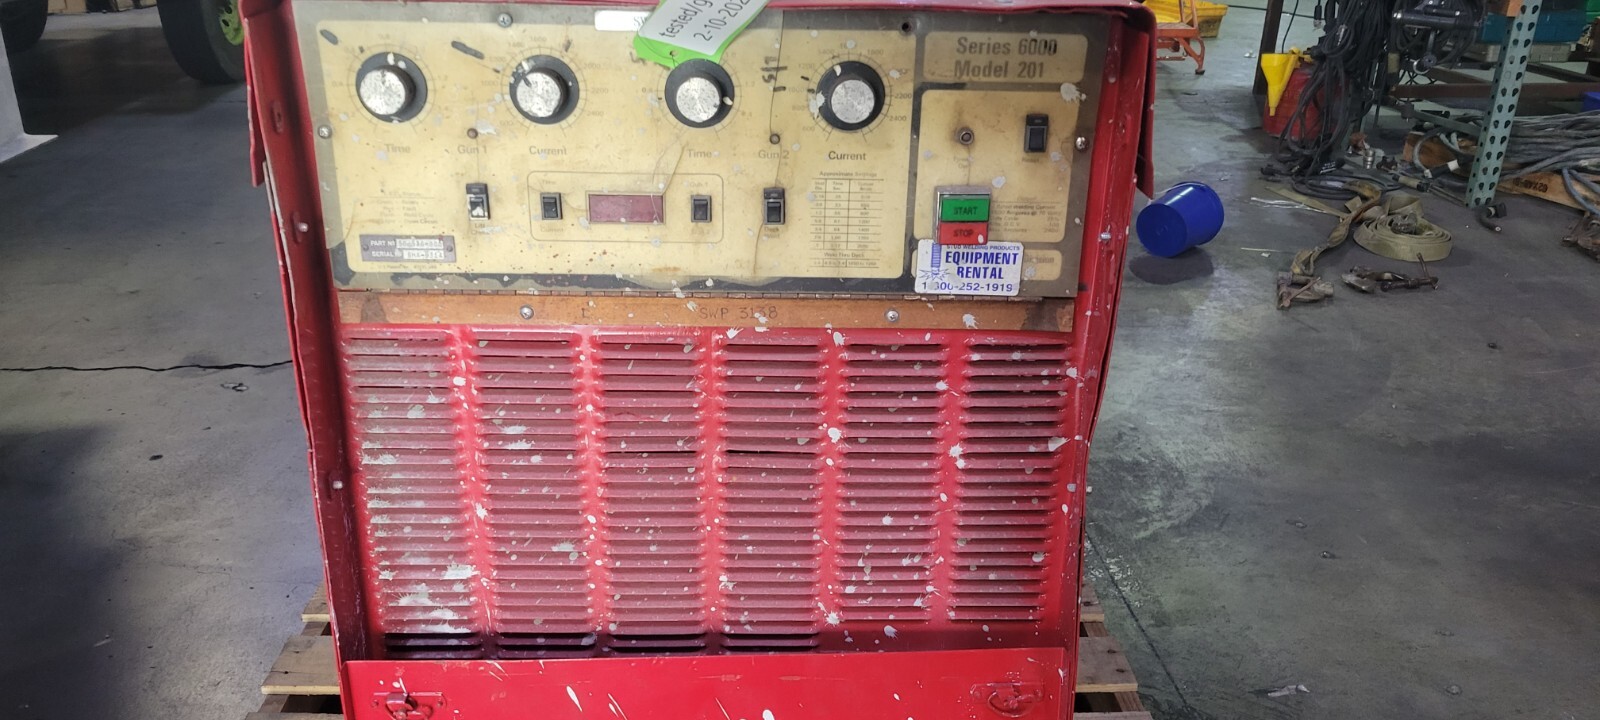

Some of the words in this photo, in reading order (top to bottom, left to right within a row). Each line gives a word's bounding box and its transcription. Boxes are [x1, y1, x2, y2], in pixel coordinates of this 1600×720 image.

[956, 36, 1011, 55] Series
[1017, 38, 1058, 56] 6000
[954, 60, 1009, 78] Model
[1017, 62, 1044, 78] 201
[384, 143, 411, 154] Time
[457, 144, 479, 155] Gun
[481, 145, 487, 155] 1
[528, 145, 567, 156] Current
[687, 149, 712, 159] Time
[757, 149, 780, 160] Gun
[782, 150, 790, 160] 2
[828, 151, 867, 161] Current
[953, 206, 978, 215] START
[953, 228, 974, 237] STOP
[945, 251, 1019, 265] EQUIPMENT
[957, 266, 1004, 279] RENTAL
[700, 307, 729, 320] SWP
[740, 306, 778, 320] 3138
